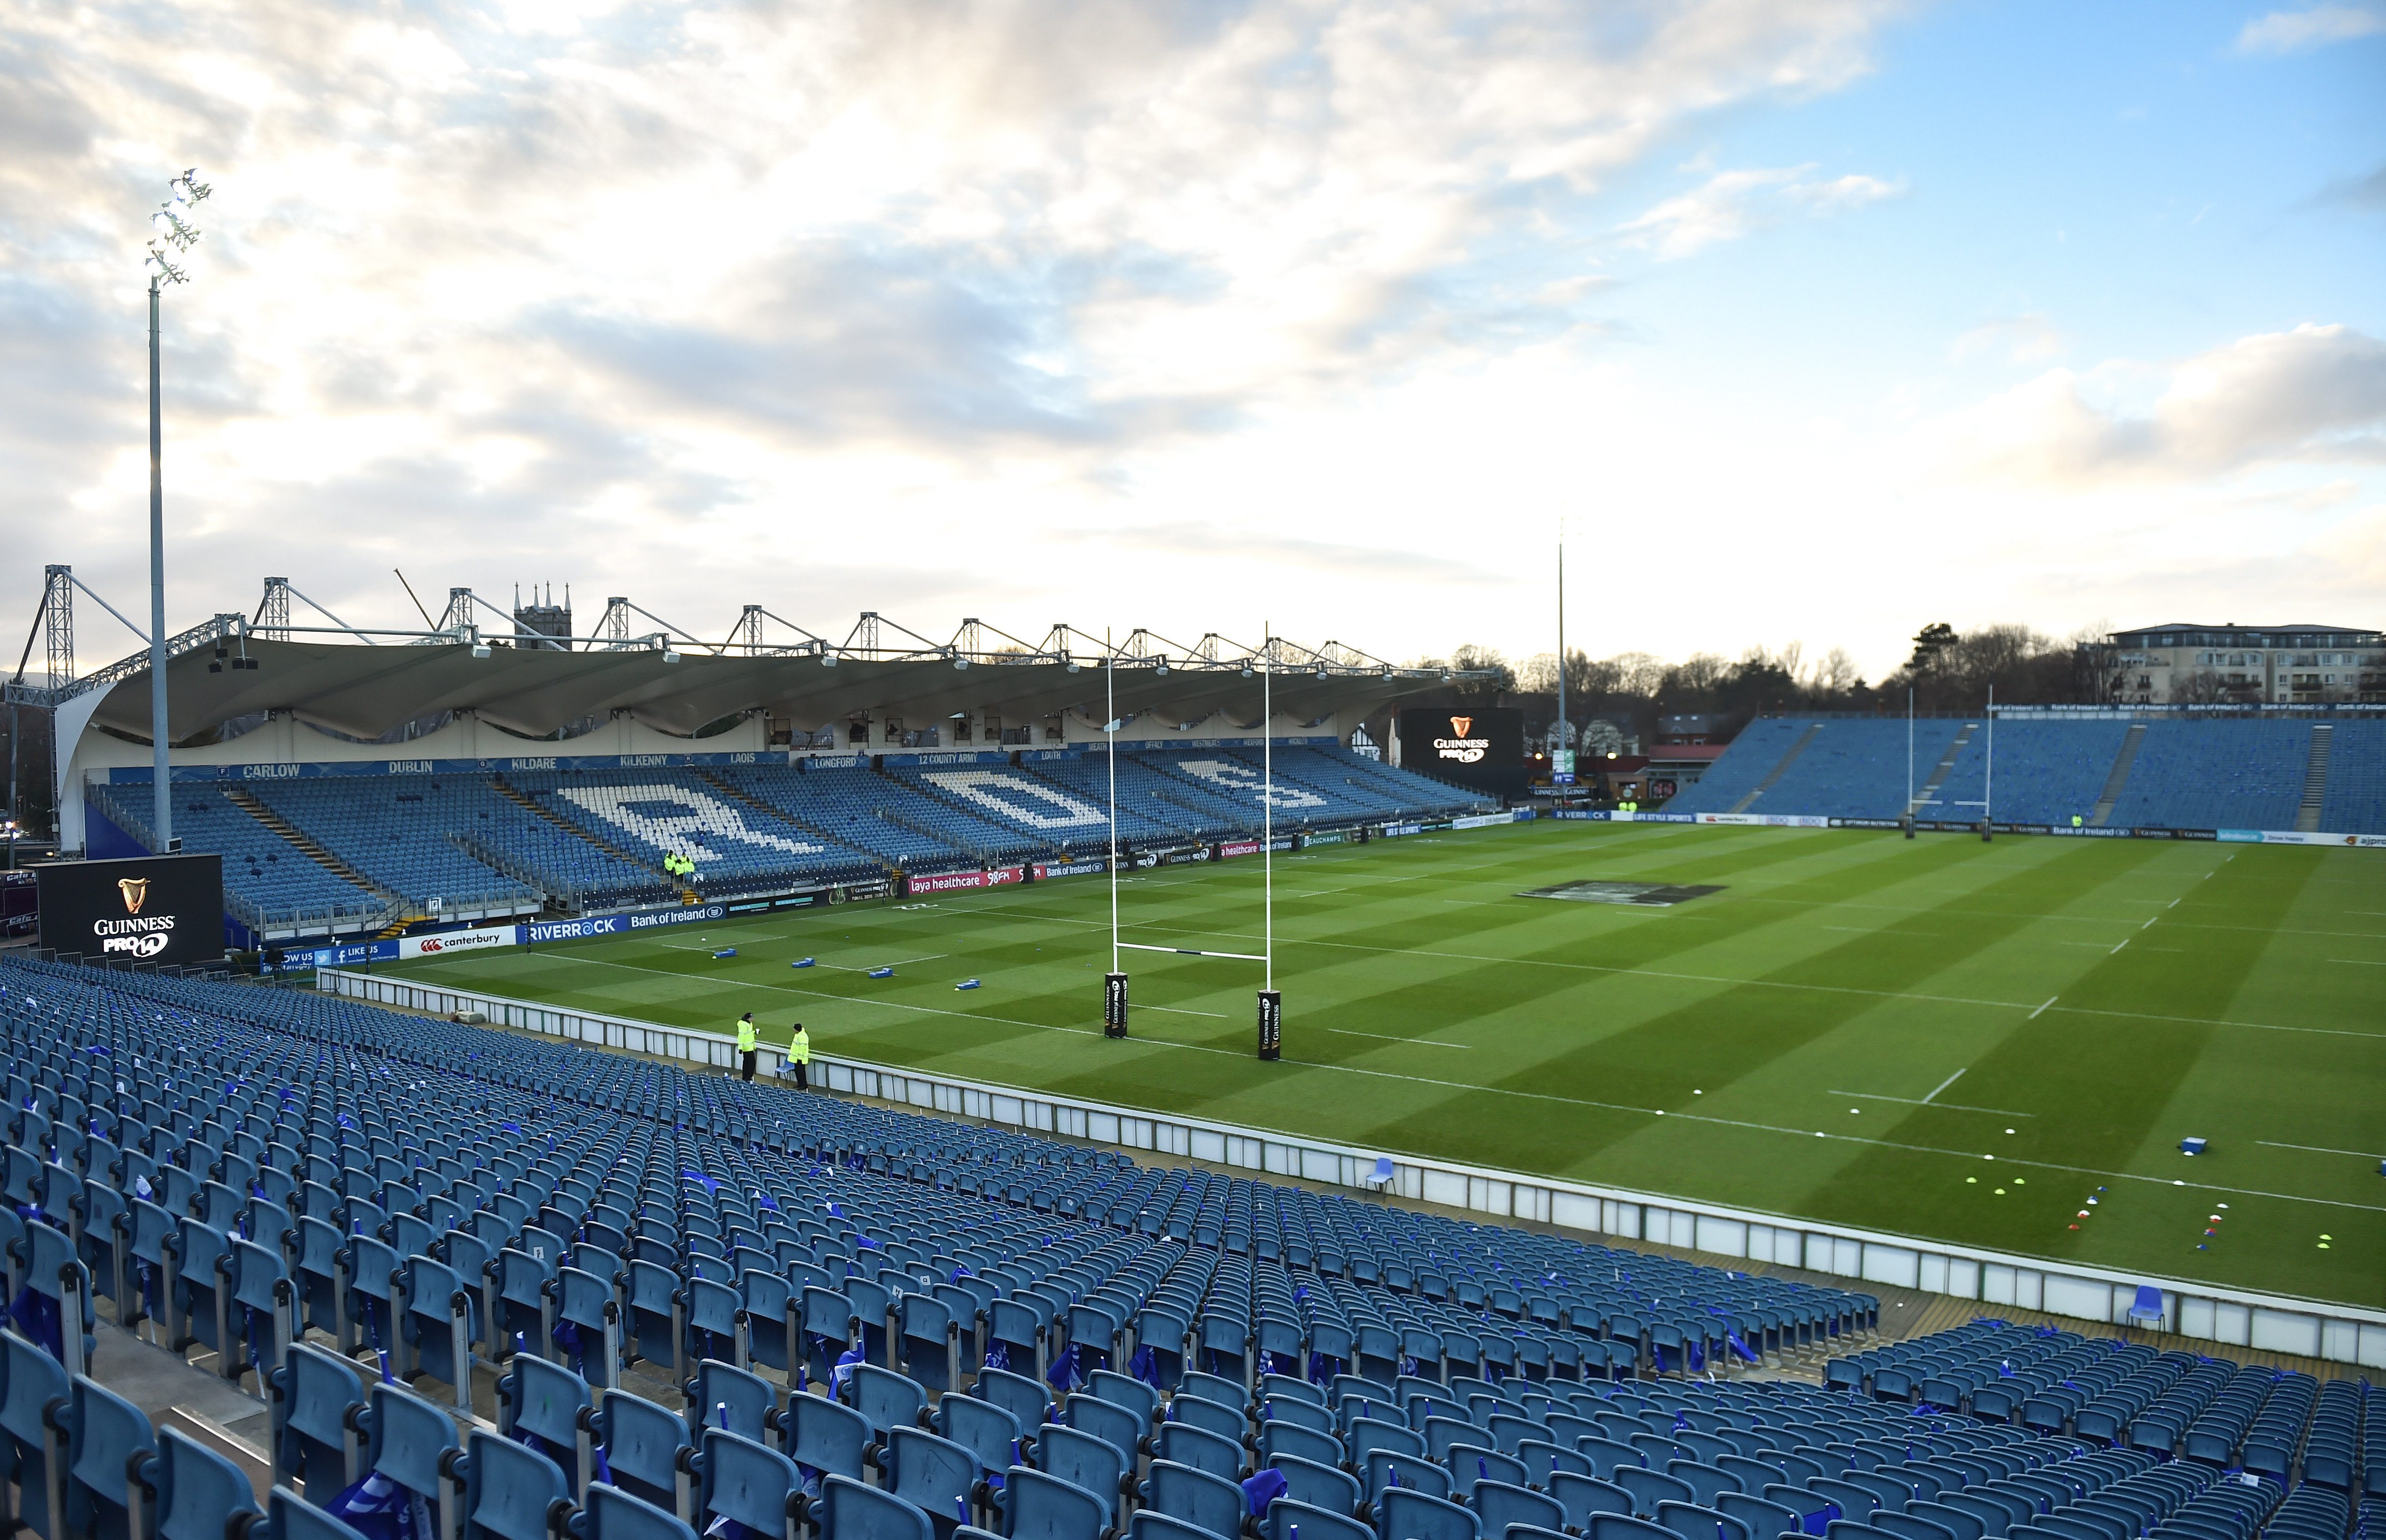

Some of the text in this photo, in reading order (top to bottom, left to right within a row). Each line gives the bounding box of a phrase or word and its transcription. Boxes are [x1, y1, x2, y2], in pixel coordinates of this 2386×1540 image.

[1088, 742, 1107, 751] MEATH
[1145, 741, 1163, 749] OFFALY
[1434, 738, 1489, 748] GUINNESS
[620, 755, 667, 766] KILKENNY
[730, 753, 756, 763] LAOIS
[919, 753, 978, 765] 12 COUNTY ARMY
[1041, 751, 1061, 760] LOUTH
[389, 761, 433, 774] DUBLIN
[511, 758, 557, 770] KILDARE
[815, 757, 856, 768] LONGFORD
[243, 764, 300, 778] CARLOW
[2053, 827, 2114, 836] Bank of Ireland
[1226, 844, 1257, 855] healthcare
[1170, 854, 1191, 863] GUINNESS
[1047, 864, 1091, 877] Bank of Ireland
[7, 872, 28, 882] Cafe
[987, 871, 1010, 886] 98FM
[911, 876, 980, 893] laya healthcare
[631, 908, 705, 927] Bank of Ireland
[94, 915, 175, 936] GUINNESS
[103, 933, 168, 957] PRO14
[444, 934, 500, 947] canterbury
[302, 953, 313, 961] US
[348, 947, 365, 956] LIKE
